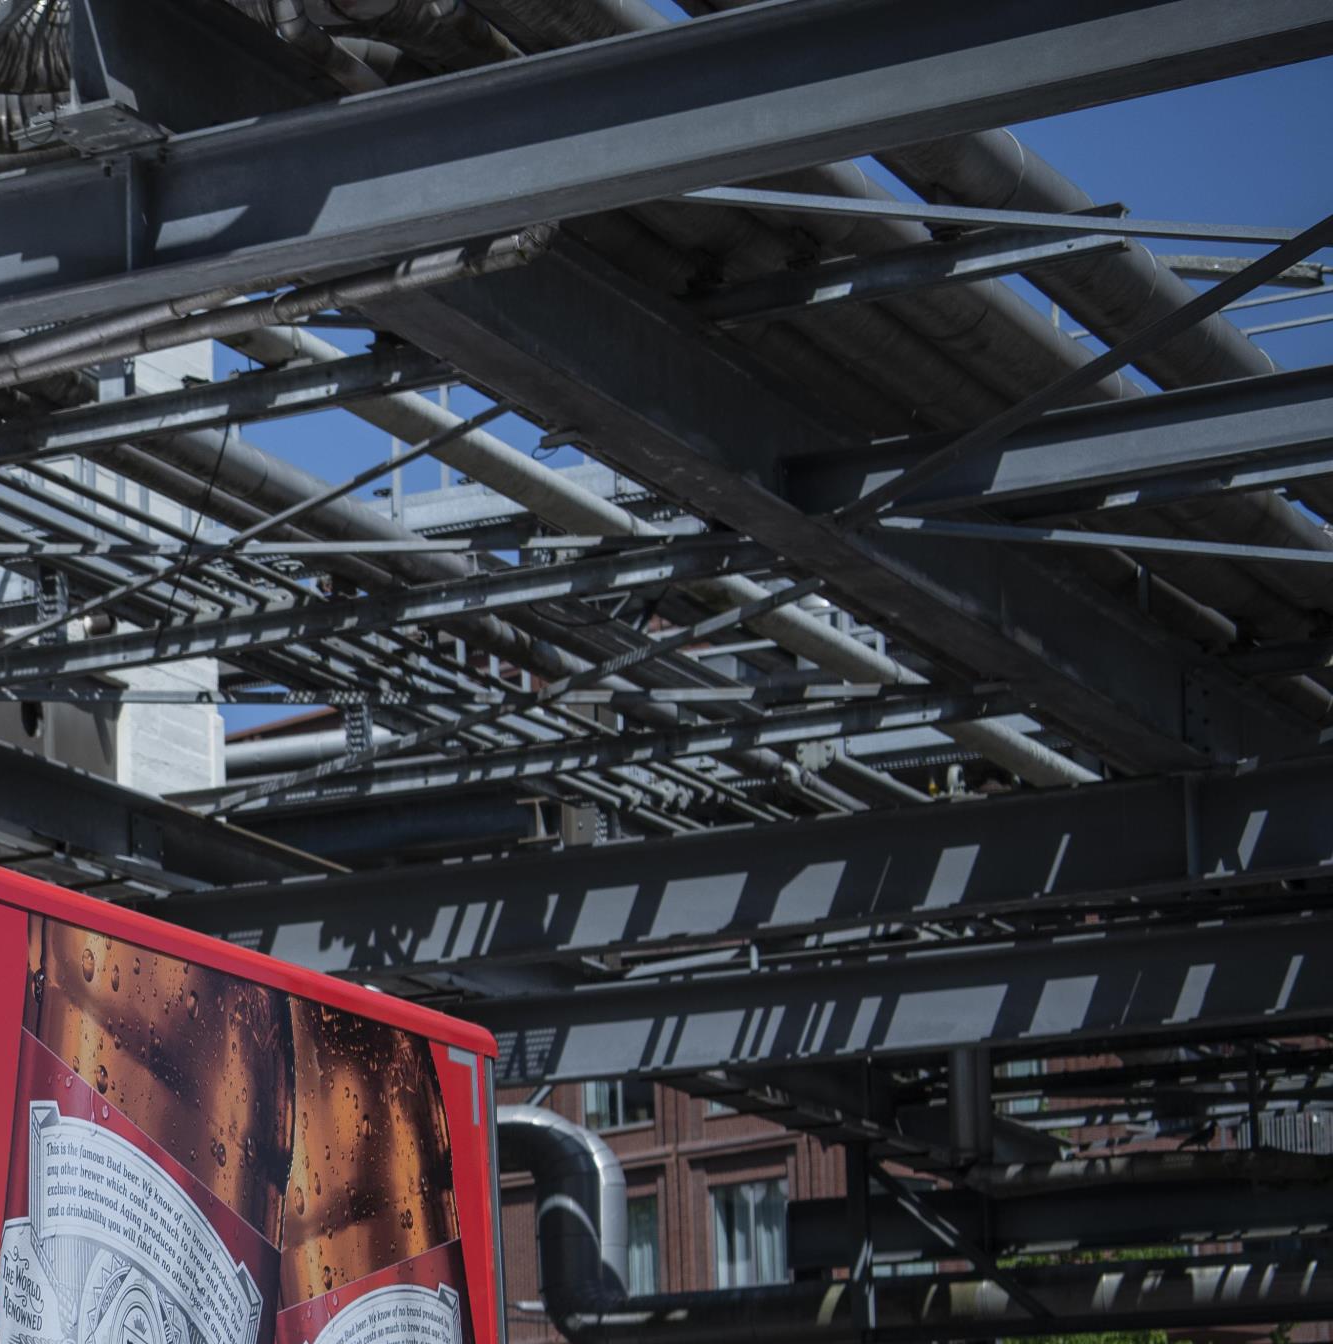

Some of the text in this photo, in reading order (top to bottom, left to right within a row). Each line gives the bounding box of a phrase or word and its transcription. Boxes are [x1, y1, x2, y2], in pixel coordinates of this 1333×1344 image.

[47, 1182, 77, 1196] exclusive
[79, 1184, 119, 1212] Beechwood
[143, 1222, 176, 1259] produces
[177, 1256, 182, 1266] a
[47, 1165, 59, 1178] any
[61, 1162, 79, 1176] other
[80, 1164, 105, 1184] brewer
[107, 1177, 127, 1198] which
[129, 1192, 147, 1212] costs
[149, 1208, 159, 1220] so
[160, 1216, 179, 1242] much
[181, 1236, 189, 1252] to
[189, 1246, 206, 1274] brew
[205, 1273, 219, 1294] and
[47, 1142, 244, 1322] This is the famous Bud beer. We know of no brand produced by
[3, 1254, 15, 1286] THE
[47, 1202, 60, 1218] and
[61, 1206, 65, 1216] a
[66, 1202, 107, 1229] drinkability
[107, 1218, 121, 1234] you
[123, 1226, 136, 1244] will
[136, 1234, 153, 1256] find
[153, 1247, 160, 1264] in
[161, 1260, 171, 1274] no
[171, 1268, 189, 1294] other
[189, 1288, 203, 1312] beer
[203, 1311, 211, 1325] at
[210, 1324, 222, 1344] any
[3, 1286, 43, 1332] RENOWNED
[401, 1322, 407, 1332] to
[406, 1304, 421, 1318] brand
